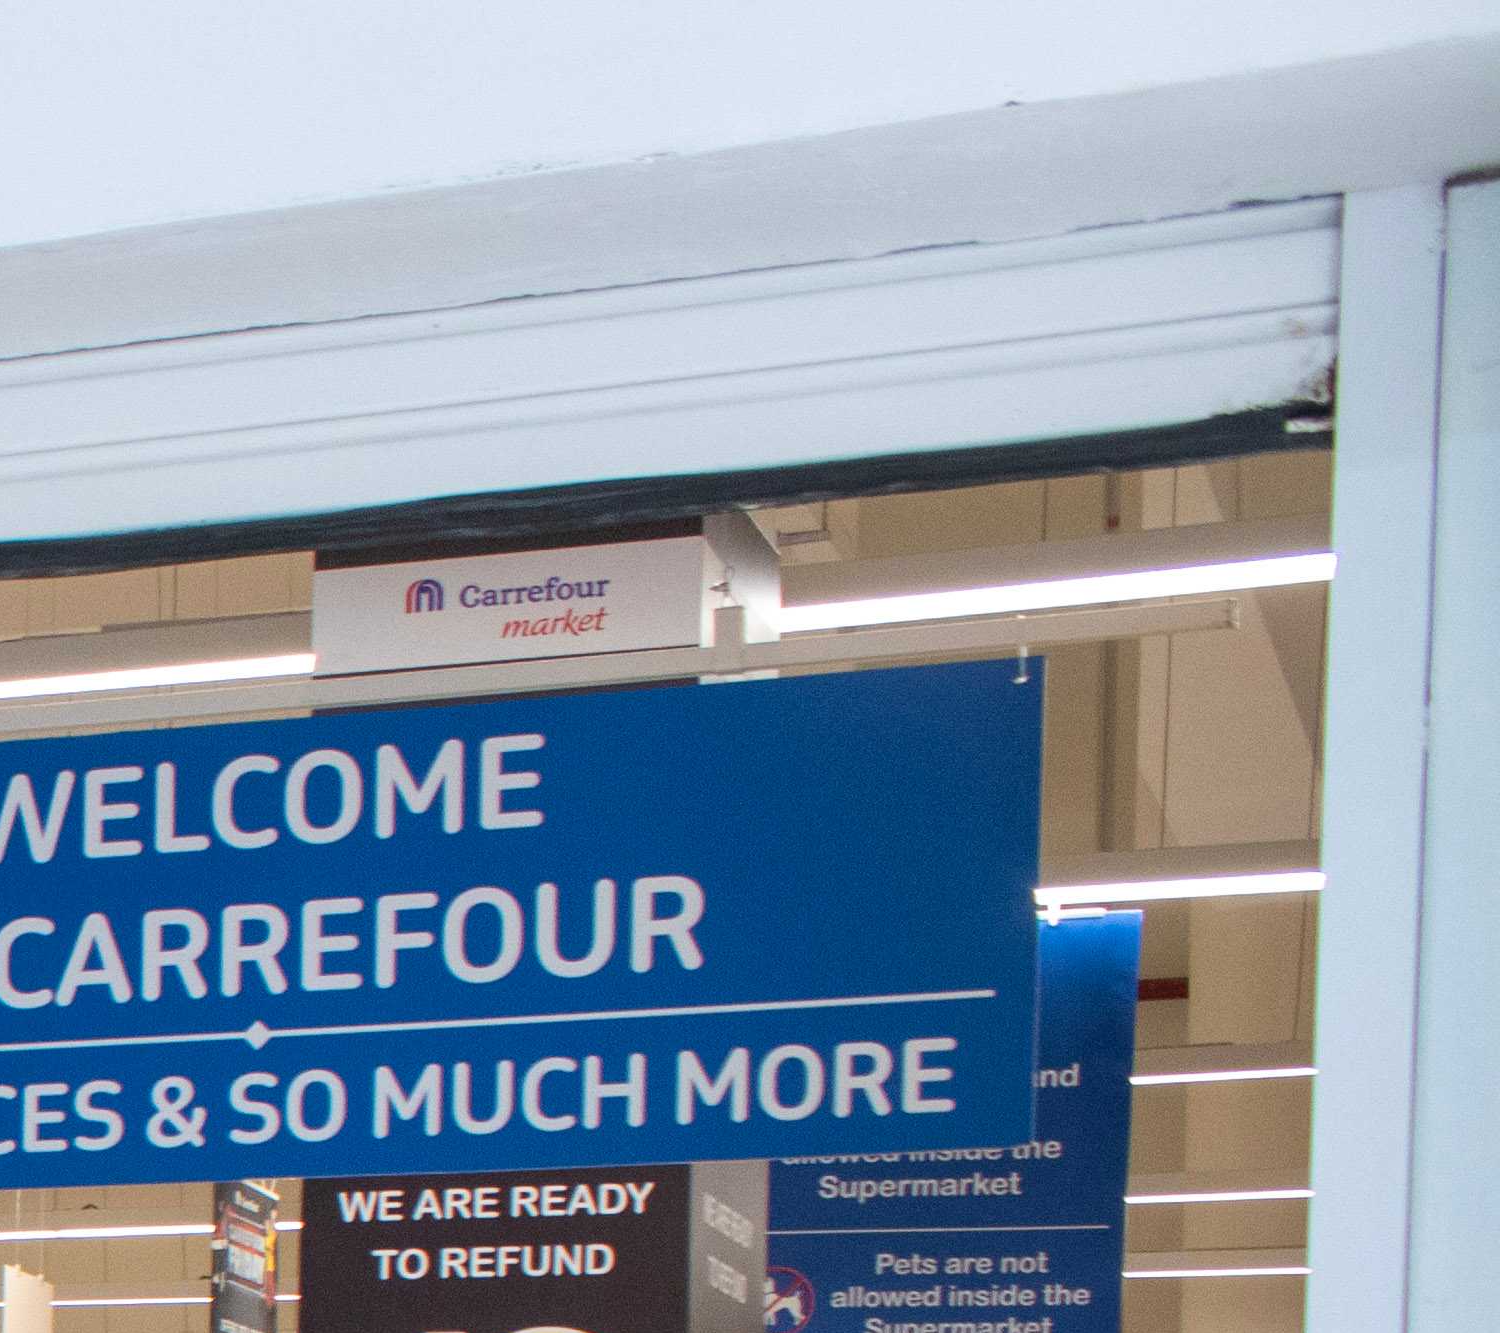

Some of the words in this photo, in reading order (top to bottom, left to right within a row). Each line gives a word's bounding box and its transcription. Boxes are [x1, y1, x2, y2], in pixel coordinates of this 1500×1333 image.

[460, 576, 610, 608] Carrefour
[146, 1076, 208, 1149] &
[228, 1069, 348, 1143] SO
[373, 1049, 644, 1137] MUCH
[677, 1037, 957, 1125] MORE
[338, 1189, 404, 1223] WE
[412, 1187, 500, 1221] ARE
[509, 1182, 655, 1219] READY
[818, 1172, 1023, 1203] Supermarket
[372, 1248, 430, 1281] TO
[438, 1243, 617, 1280] REFUND
[874, 1253, 939, 1276] Pets
[943, 1256, 994, 1275] are
[1000, 1252, 1051, 1275] not
[829, 1286, 942, 1309] allowed
[947, 1285, 1036, 1308] inside
[1042, 1284, 1092, 1306] the
